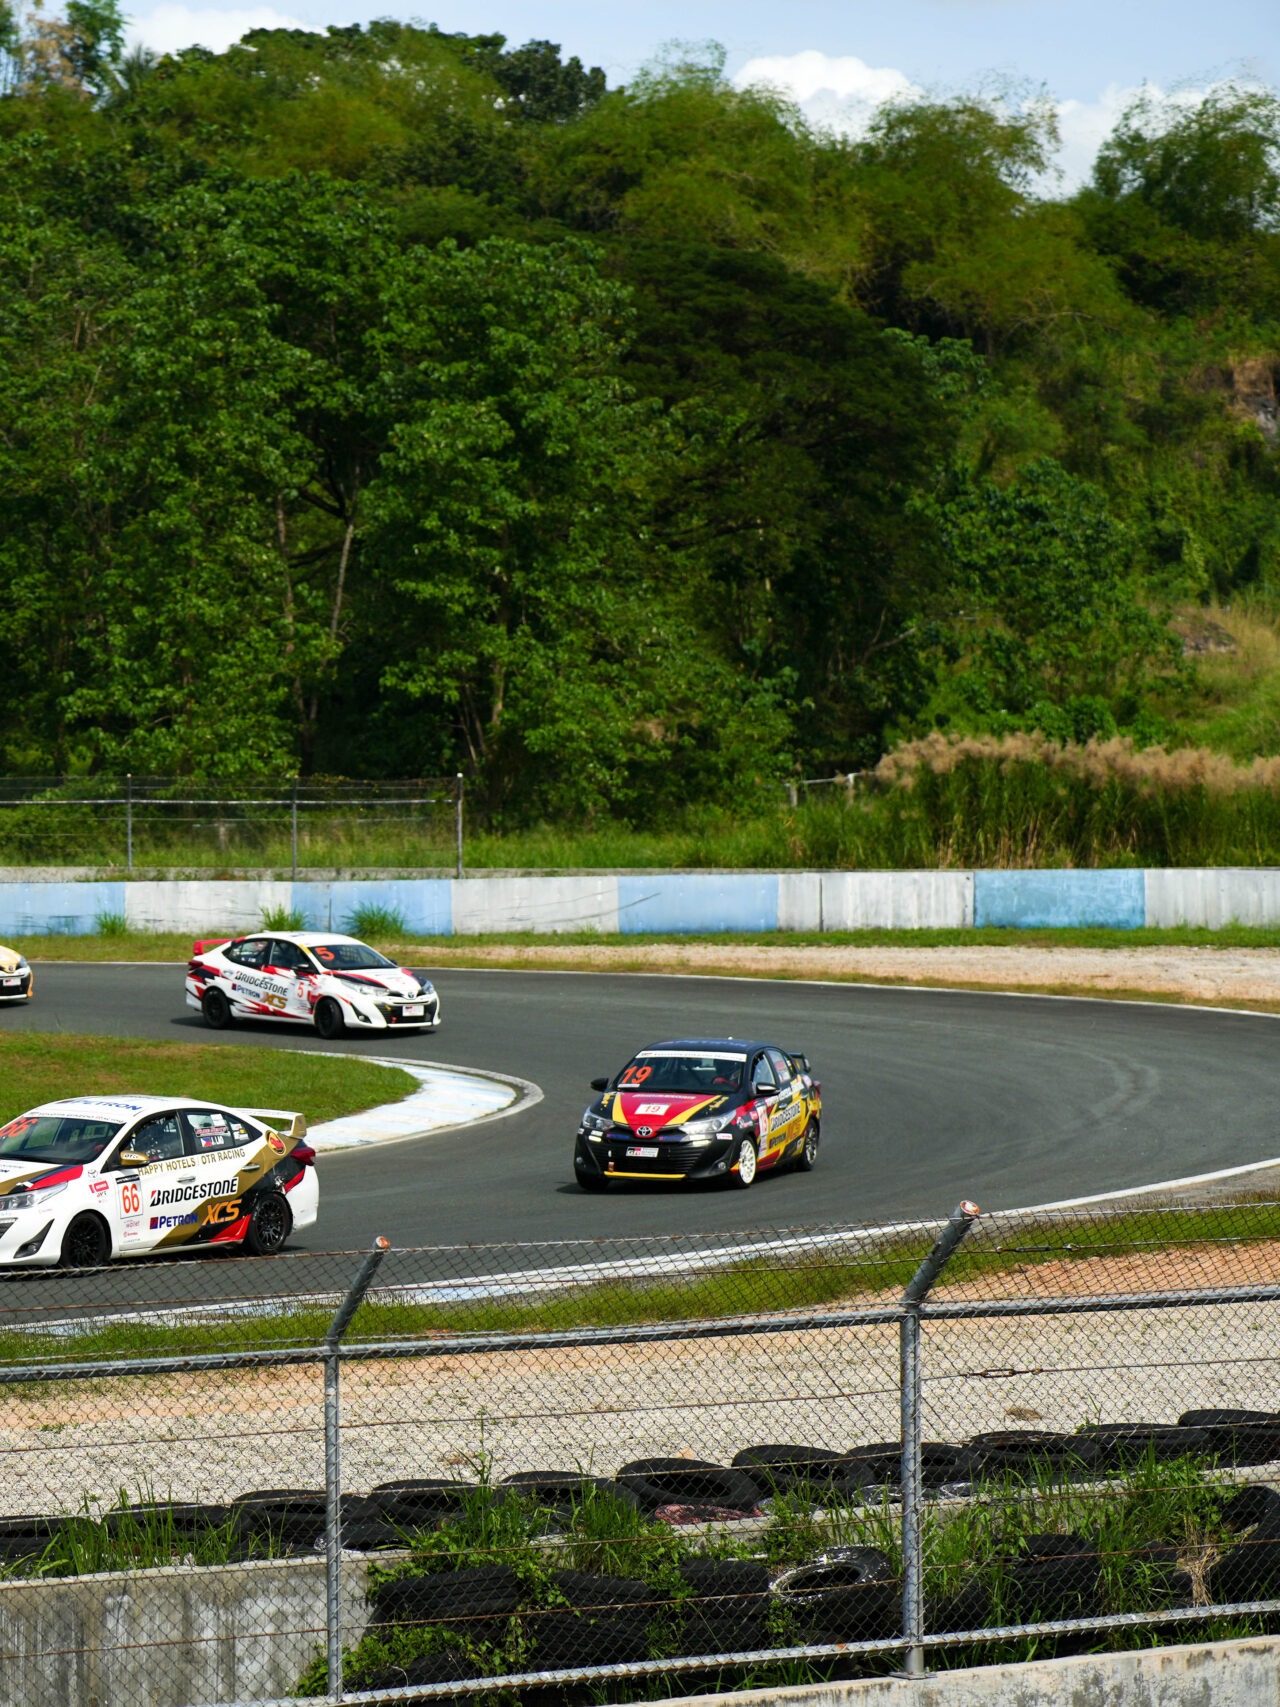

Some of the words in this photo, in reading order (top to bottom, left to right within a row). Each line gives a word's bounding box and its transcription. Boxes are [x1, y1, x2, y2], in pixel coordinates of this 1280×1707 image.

[314, 947, 335, 960] 5
[234, 971, 288, 997] BRIDGESTONE
[237, 984, 261, 998] PETRON
[297, 982, 305, 998] 5
[263, 992, 288, 1009] XCS
[621, 1065, 652, 1085] 19
[645, 1104, 661, 1113] 19
[770, 1102, 801, 1132] BRIDGESTONE
[138, 1163, 164, 1176] HAPPY
[166, 1158, 196, 1171] HOTELS
[201, 1153, 217, 1165] OTR
[218, 1148, 246, 1161] RACING
[122, 1183, 140, 1214] 66
[149, 1178, 238, 1208] BRIDGESTONE
[159, 1212, 198, 1229] PETRON
[202, 1199, 243, 1226] XCS
